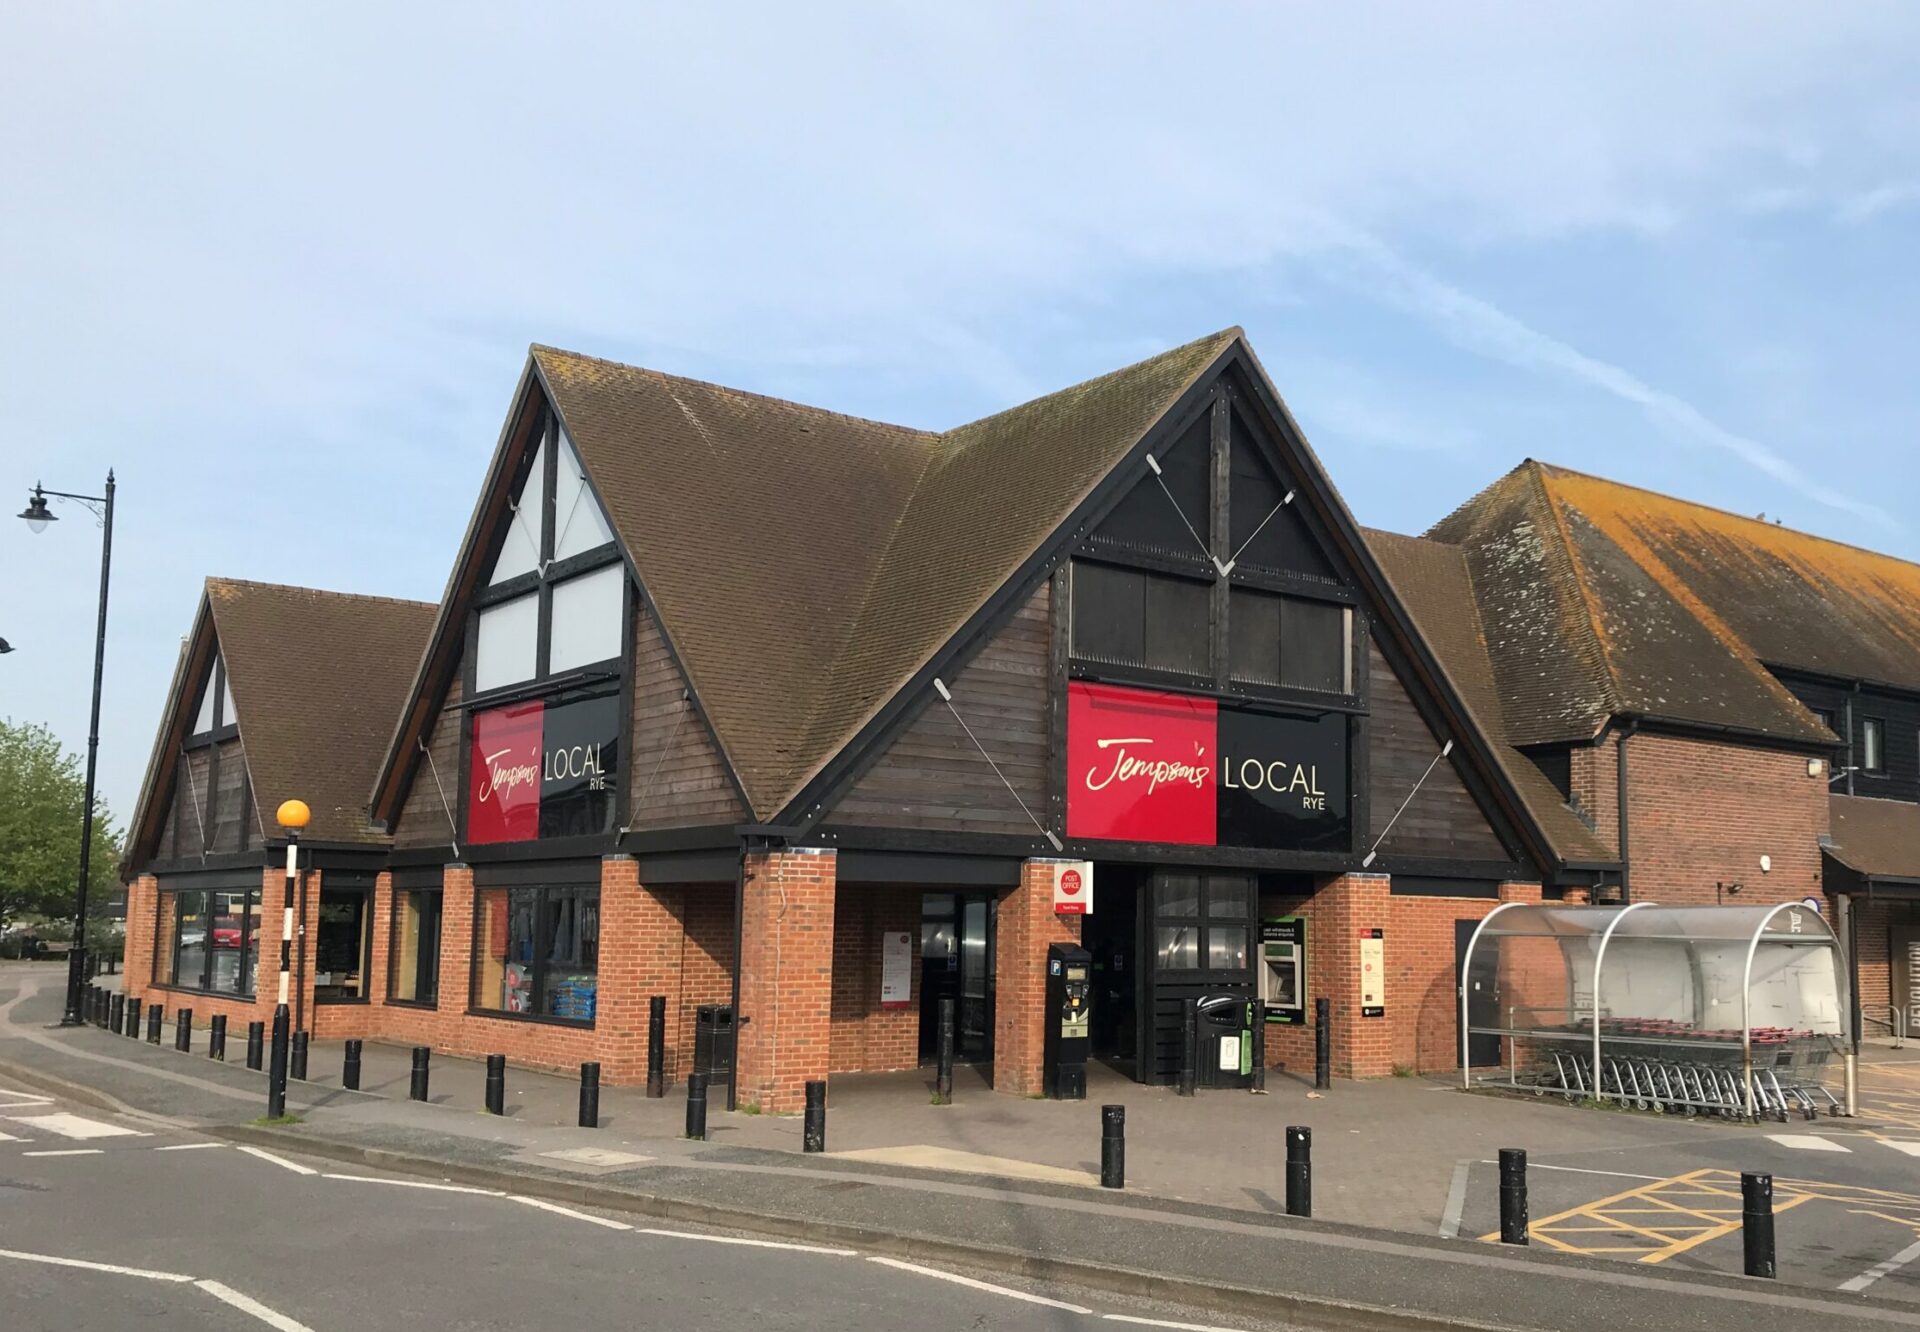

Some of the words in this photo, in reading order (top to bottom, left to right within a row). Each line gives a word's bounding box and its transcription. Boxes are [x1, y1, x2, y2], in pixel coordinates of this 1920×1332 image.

[544, 743, 606, 781] LOCAL
[590, 776, 605, 790] RYE
[1225, 757, 1326, 795] LOCAL
[1302, 797, 1326, 811] RYE
[1065, 874, 1078, 882] POST
